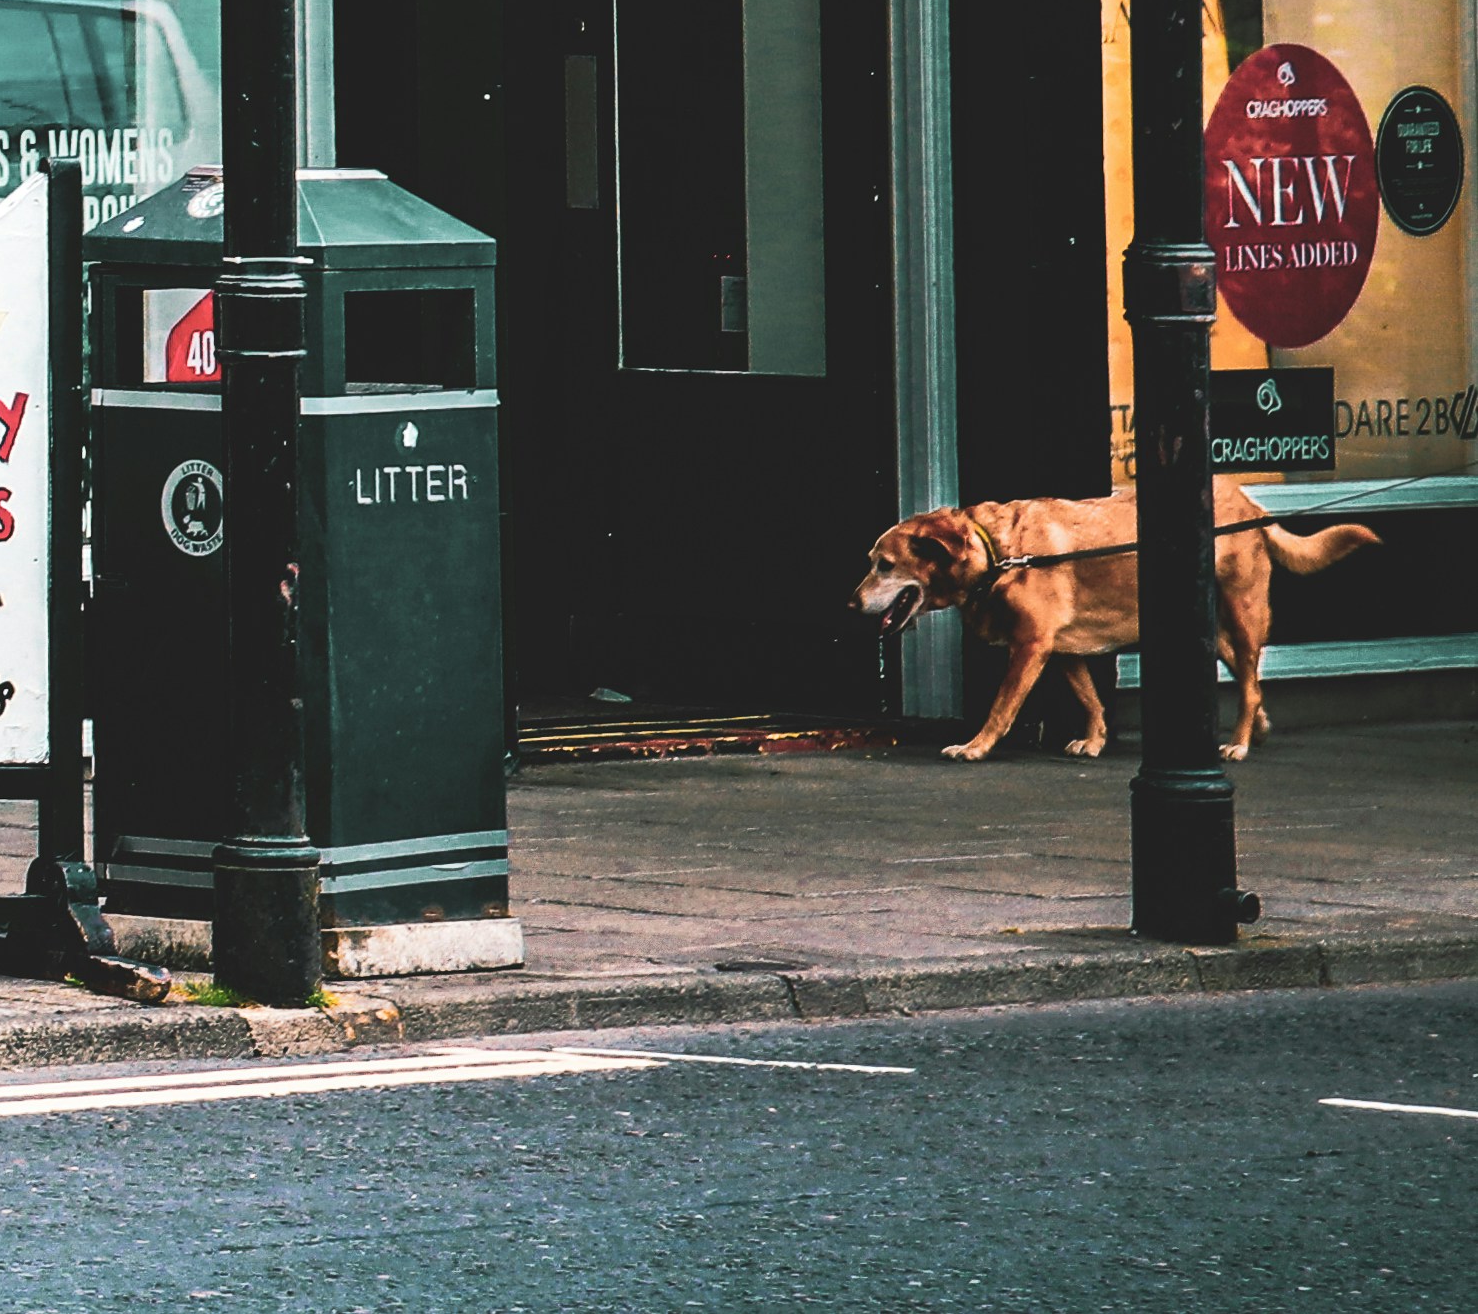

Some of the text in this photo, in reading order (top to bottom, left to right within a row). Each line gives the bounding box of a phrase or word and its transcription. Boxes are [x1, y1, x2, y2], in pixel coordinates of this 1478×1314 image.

[1246, 98, 1328, 118] CRAGHOPPERS
[20, 129, 40, 183] &
[49, 128, 174, 185] WOMENS
[1221, 154, 1357, 228] NEW
[1224, 240, 1359, 272] LINES ADDED
[1211, 435, 1330, 463] CRAGHOPPERS
[356, 465, 470, 505] LITTER
